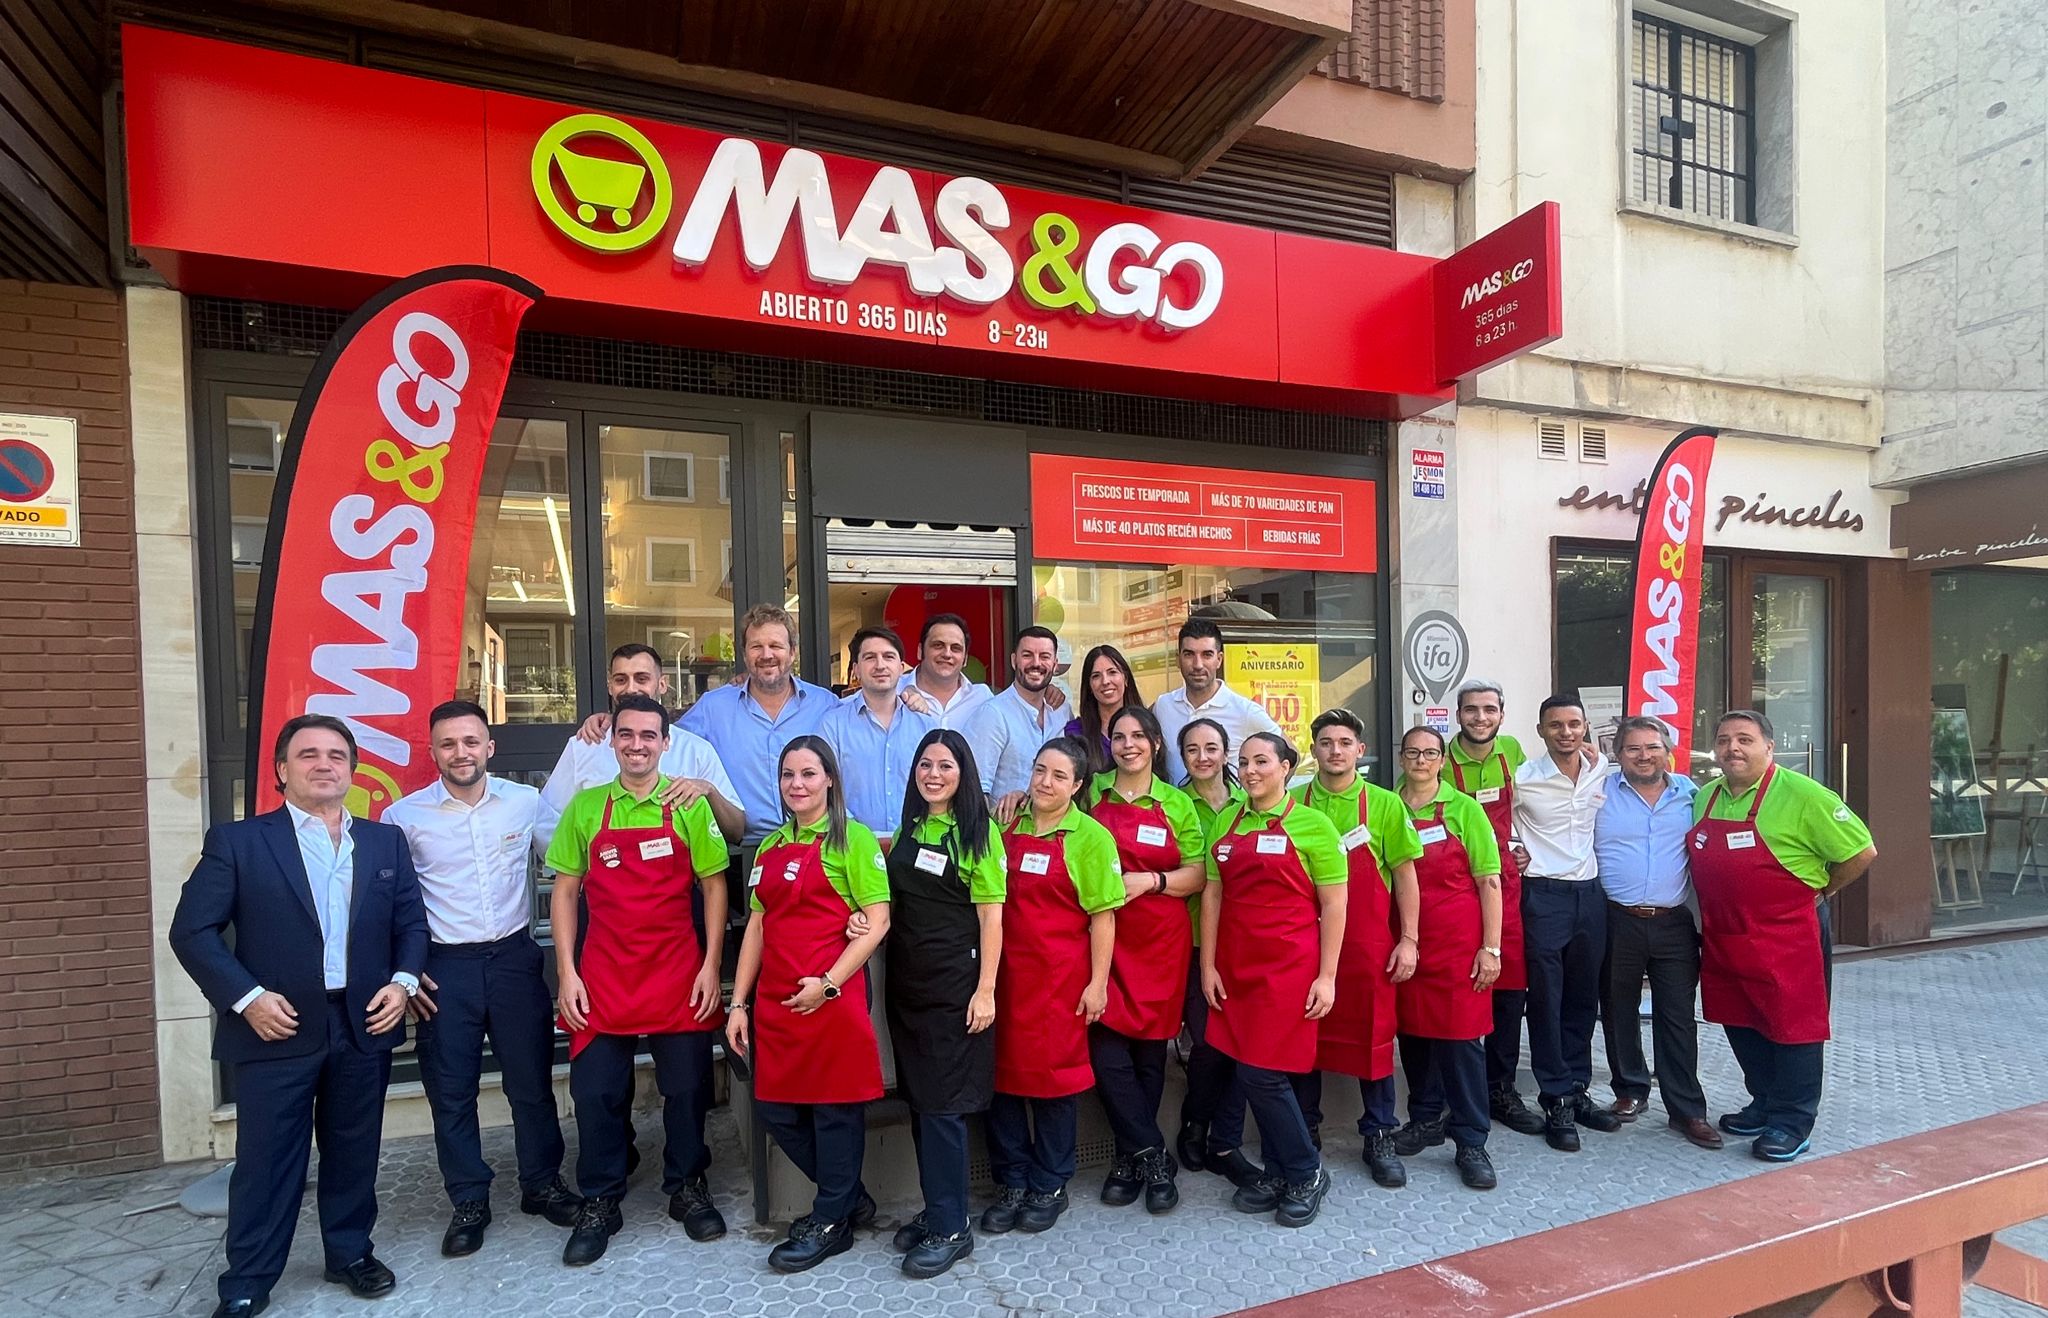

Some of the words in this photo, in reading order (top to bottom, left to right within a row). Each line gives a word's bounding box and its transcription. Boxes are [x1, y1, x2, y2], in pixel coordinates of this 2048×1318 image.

[672, 137, 1224, 332] MAS&GO
[1460, 257, 1534, 310] MAS&GO
[759, 290, 849, 325] ABIERTO
[857, 303, 897, 331] 365
[903, 308, 948, 337] DIAS
[1475, 308, 1494, 329] 365
[1475, 333, 1483, 347] 8
[1484, 332, 1491, 344] a
[1492, 322, 1506, 340] 23
[1413, 452, 1443, 465] ALARMA
[1413, 466, 1444, 480] JESMON
[1081, 483, 1121, 499] FRESCOS
[1123, 486, 1135, 500] DE
[1137, 487, 1190, 504] TEMPORADA
[1211, 491, 1230, 507] MÁS
[1231, 495, 1242, 509] DE
[1243, 495, 1255, 509] 70
[1256, 496, 1306, 513] VARIEDADES
[1306, 500, 1317, 513] DE
[1318, 501, 1334, 514] PAN
[1559, 477, 1648, 514] ent
[1715, 489, 1864, 534] pinceles
[304, 311, 470, 767] MAS&GO
[1082, 517, 1103, 533] MÁS
[1105, 520, 1117, 534] DE
[1118, 521, 1131, 535] 40
[1132, 521, 1165, 537] PLATOS
[1167, 522, 1198, 539] RECIÉN
[1199, 525, 1233, 540] HECHOS
[1263, 529, 1297, 544] BEBIDAS
[1298, 529, 1321, 545] FRÍAS
[1913, 547, 1968, 561] entre
[1975, 523, 2048, 556] pinceles
[1641, 462, 1694, 747] MAS&GO
[1240, 661, 1304, 671] ANIVERSARIO
[1423, 644, 1451, 671] ifa
[1249, 680, 1299, 691] Regalamos
[1251, 692, 1300, 723] 00
